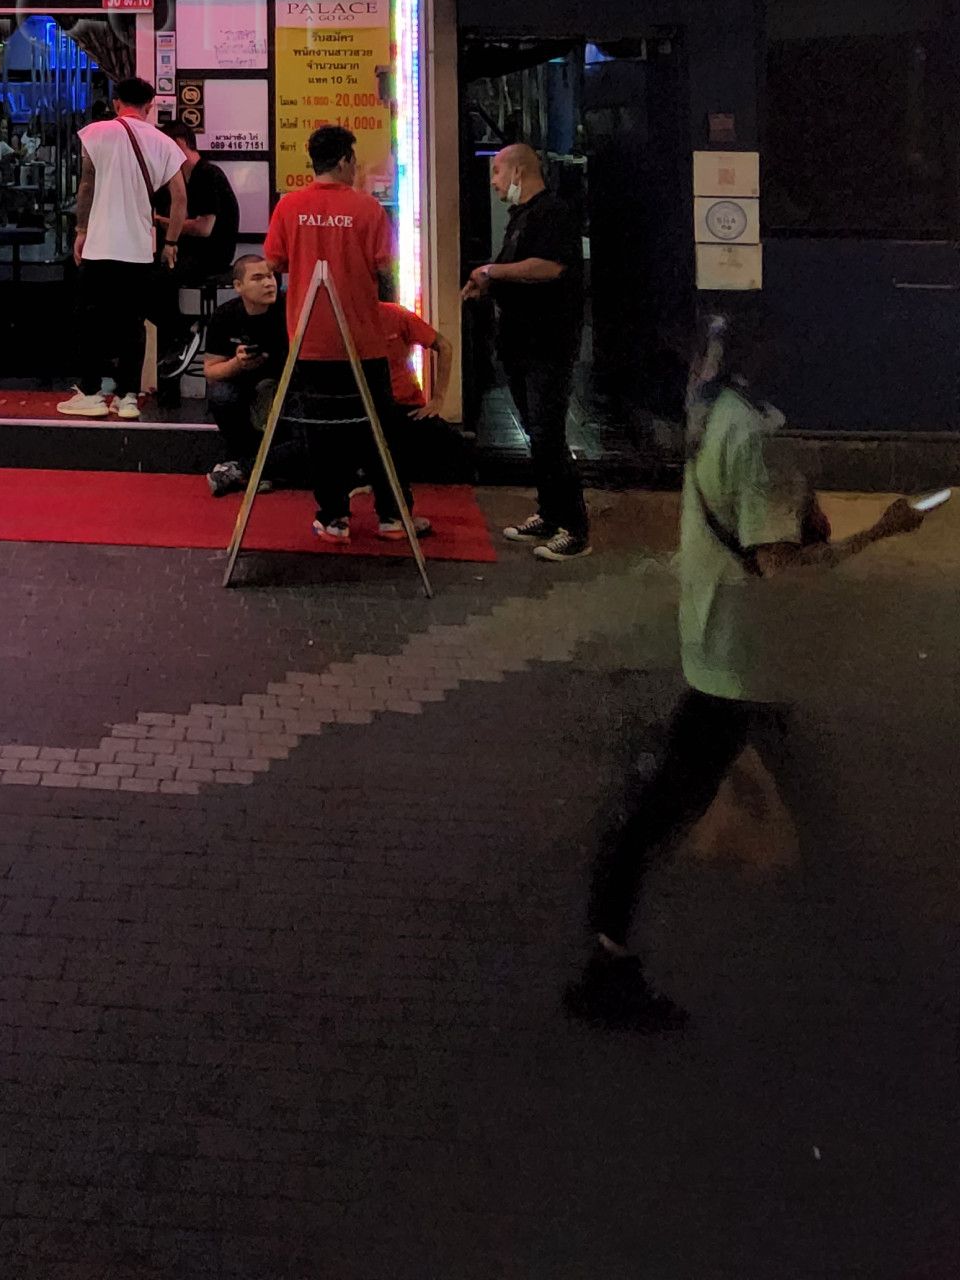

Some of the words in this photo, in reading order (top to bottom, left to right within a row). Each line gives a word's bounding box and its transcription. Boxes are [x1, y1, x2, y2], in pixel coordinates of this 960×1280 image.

[287, 2, 378, 15] PALACE
[319, 14, 336, 22] GO
[331, 76, 343, 85] 10
[345, 75, 358, 85] วัน
[210, 141, 226, 150] 089
[227, 141, 243, 150] 416
[244, 141, 264, 150] 7151
[298, 214, 353, 228] PALACE
